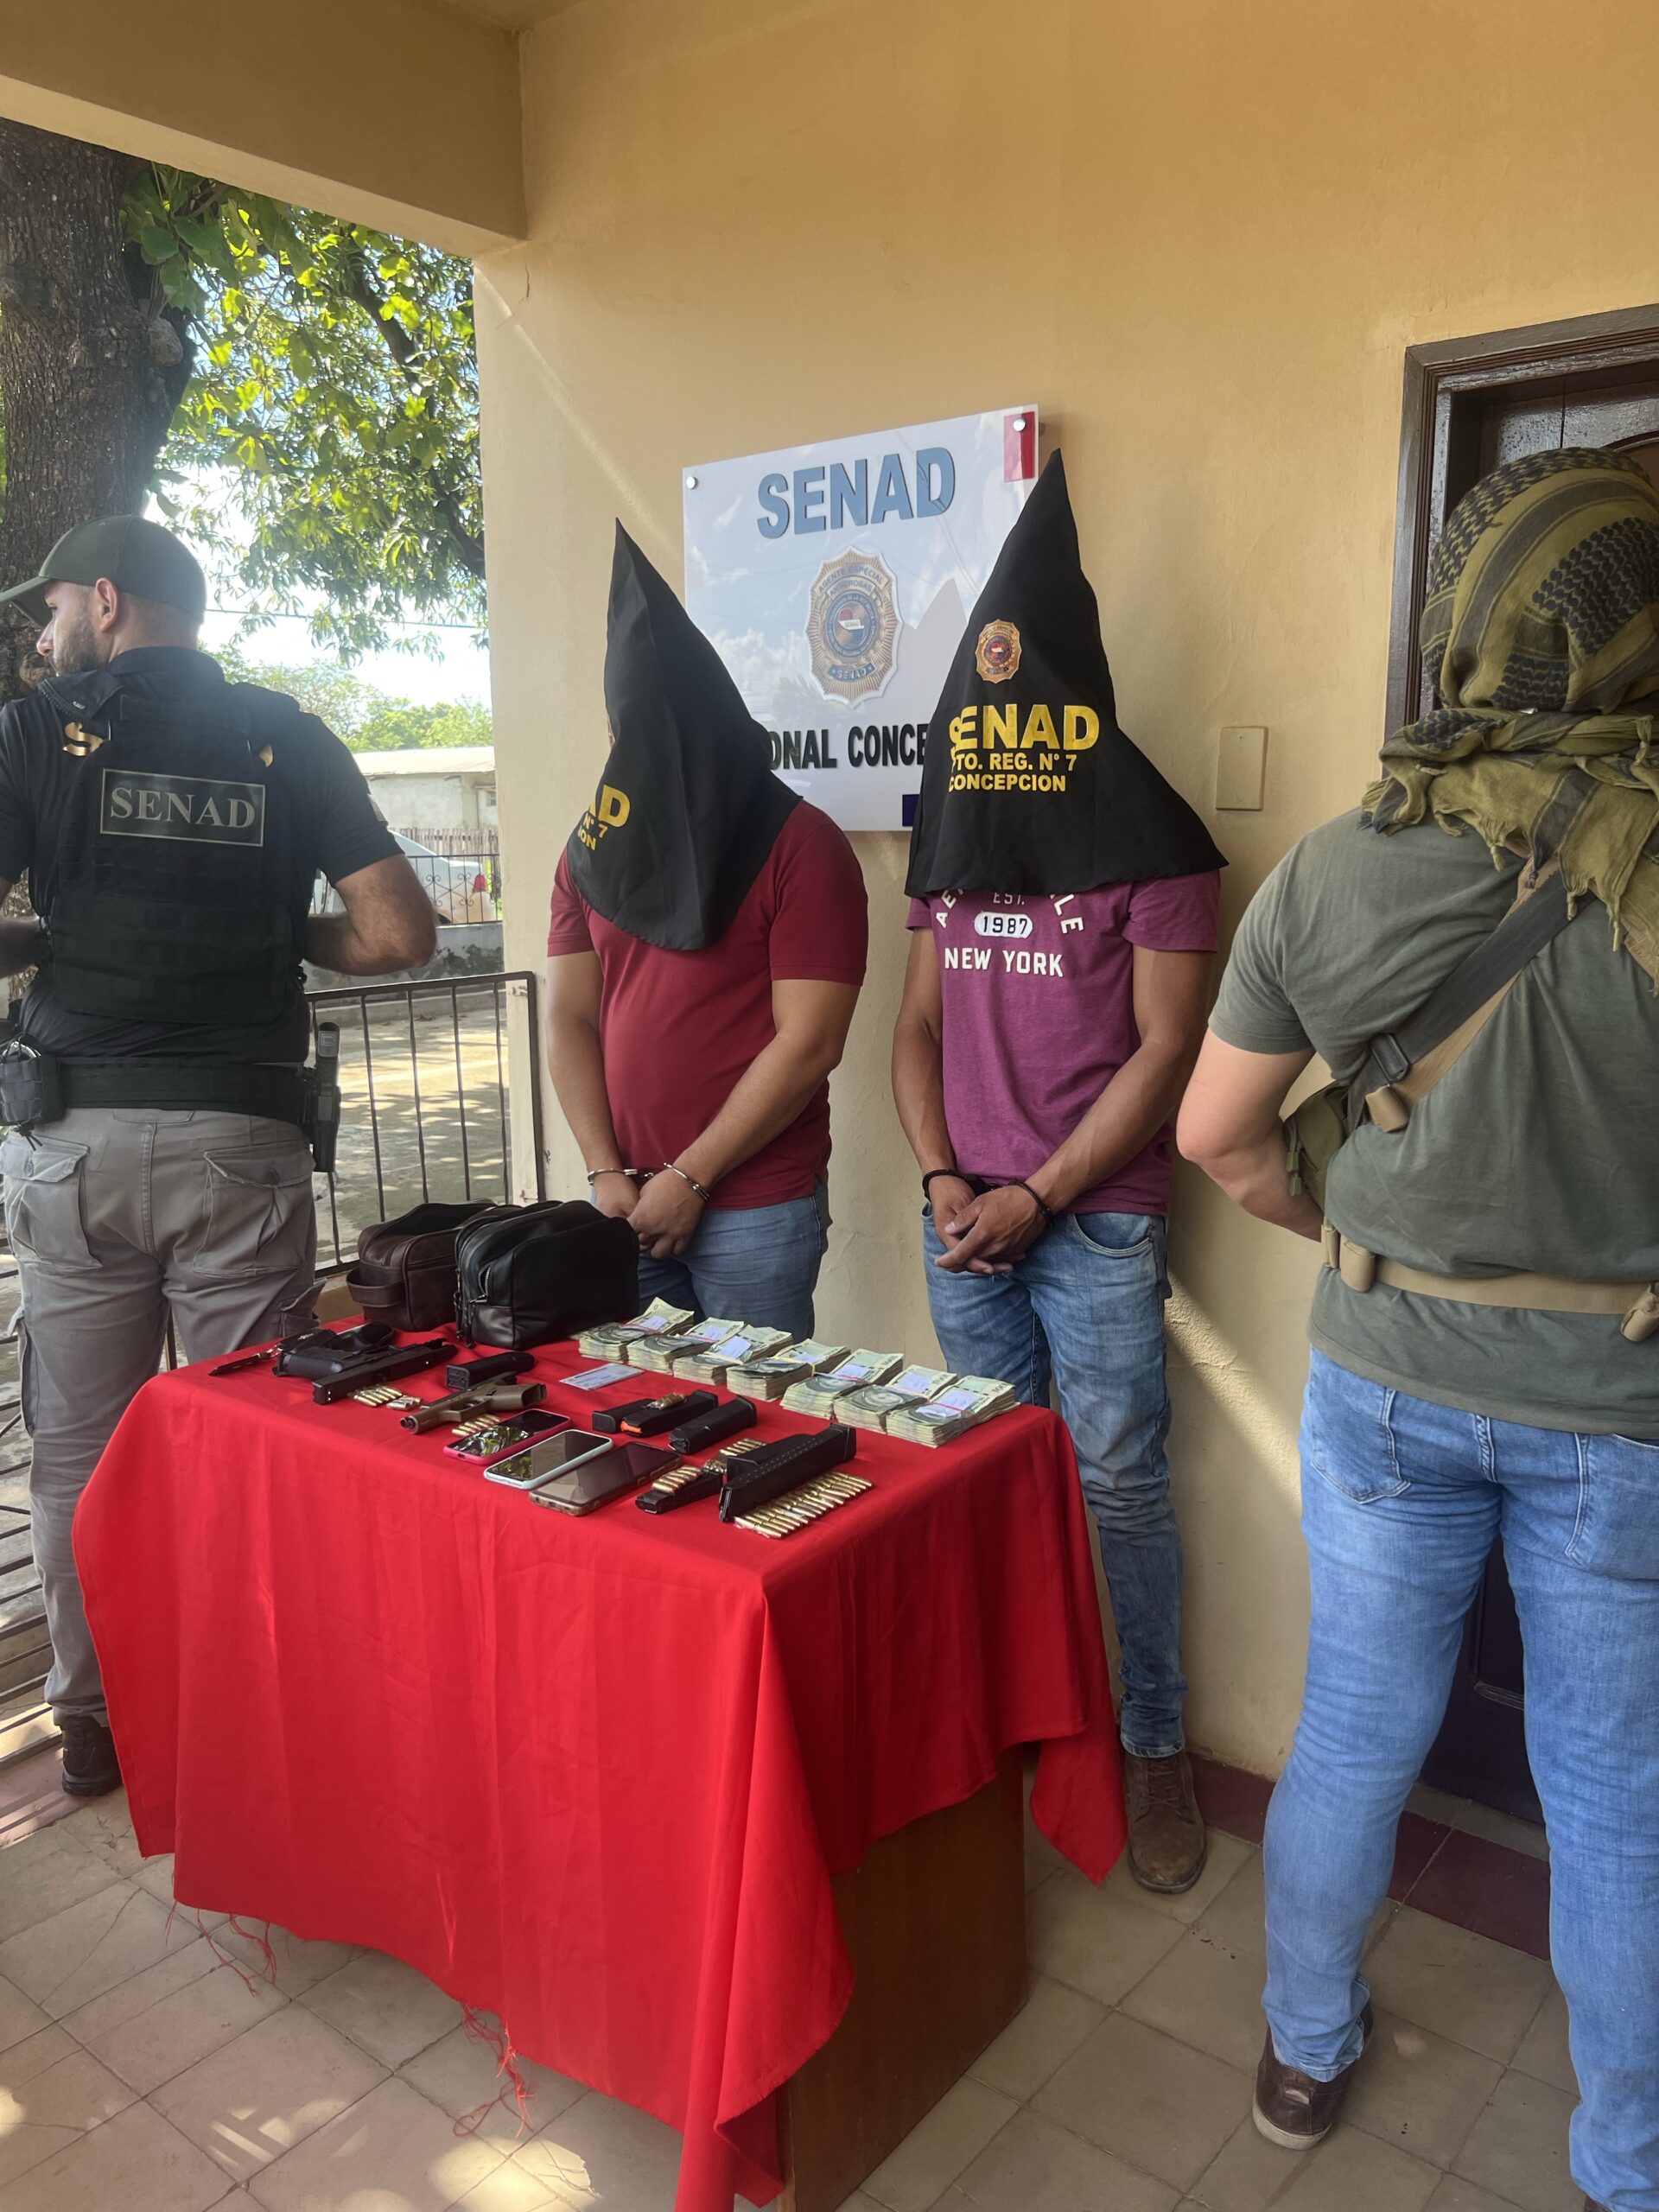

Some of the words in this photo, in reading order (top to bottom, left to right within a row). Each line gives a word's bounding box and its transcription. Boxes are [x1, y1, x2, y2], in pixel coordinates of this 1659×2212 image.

[757, 447, 956, 539] SENAD
[837, 665, 868, 679] SENAD
[989, 753, 1033, 771] REG.
[1065, 754, 1077, 771] 7
[949, 774, 1065, 791] CONCEPCION
[111, 787, 256, 829] SENAD
[598, 823, 608, 838] 7
[983, 916, 1027, 935] 1987
[944, 947, 992, 970] NEW
[1002, 950, 1064, 977] YORK
